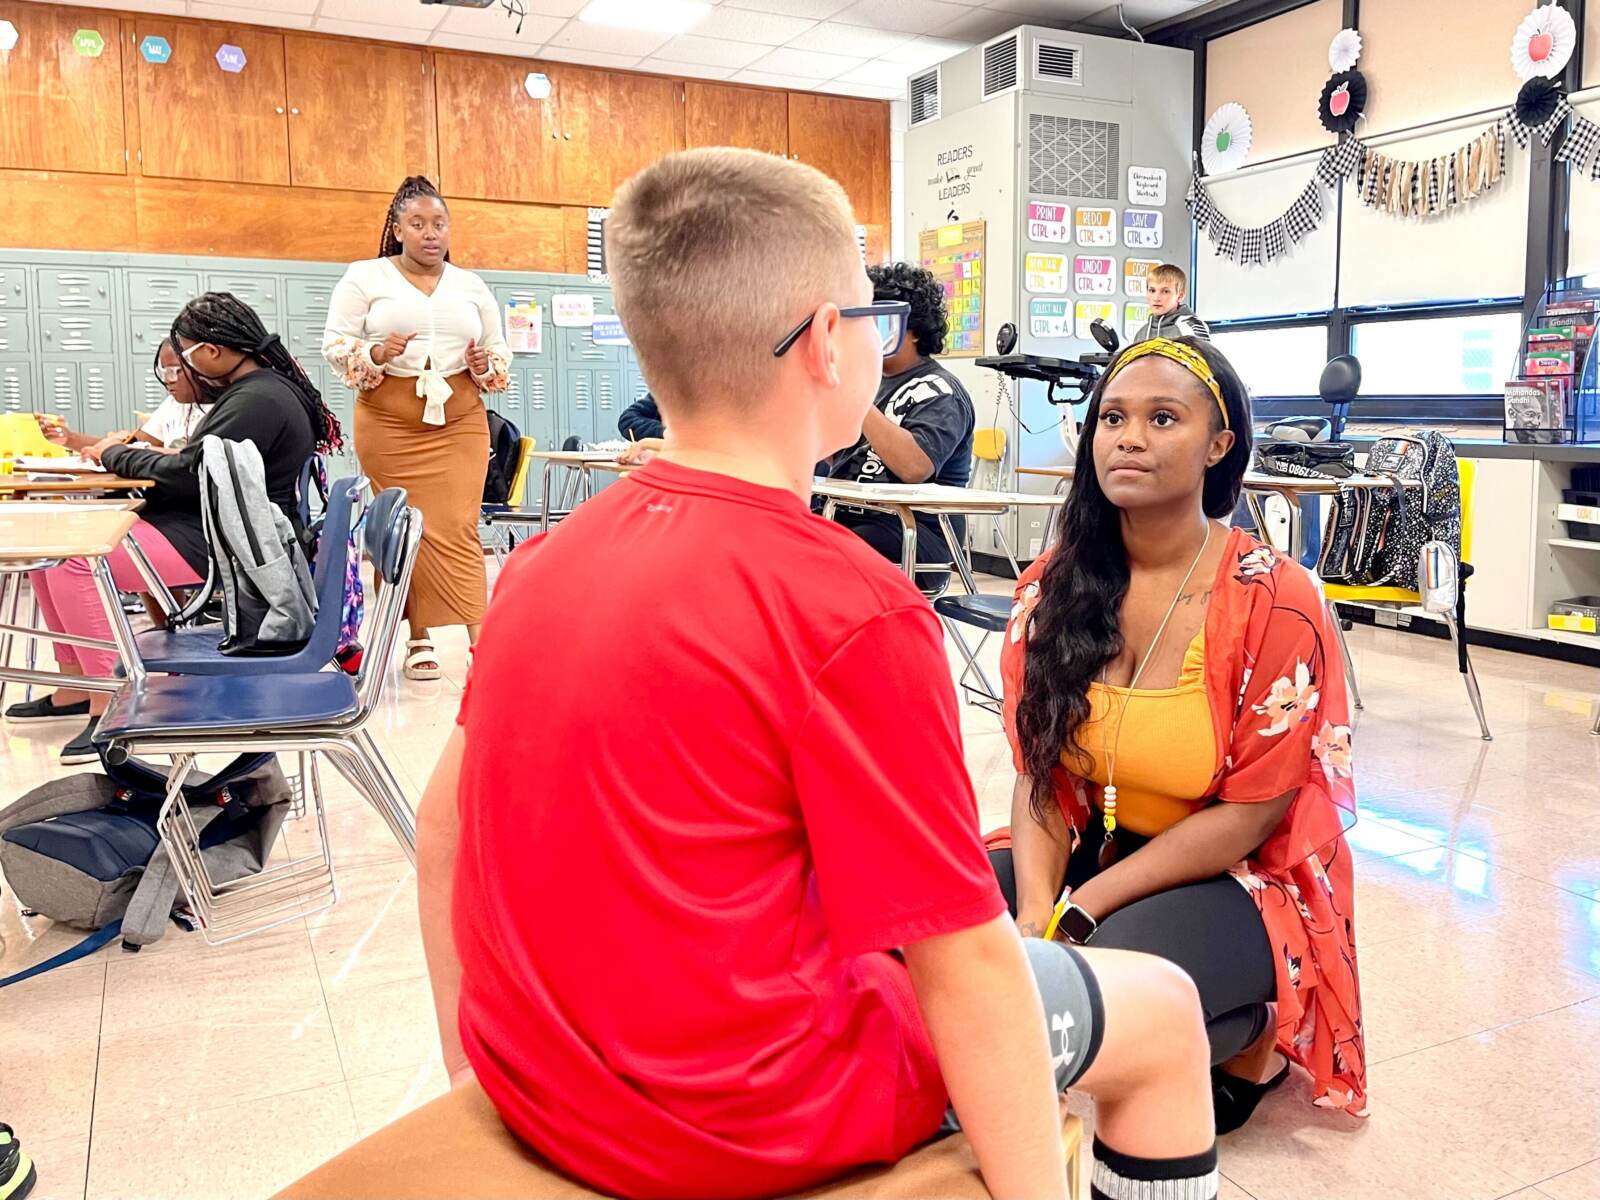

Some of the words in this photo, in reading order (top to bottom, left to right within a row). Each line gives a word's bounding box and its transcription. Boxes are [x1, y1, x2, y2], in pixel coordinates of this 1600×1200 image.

[937, 144, 973, 166] READERS
[938, 182, 971, 201] LEADERS
[1035, 205, 1057, 221] PRINT
[1083, 211, 1103, 225] REDO
[1131, 213, 1148, 227] SAVE
[1031, 223, 1049, 238] CTRL
[1060, 226, 1066, 240] P
[1079, 229, 1095, 243] CTRL
[1127, 231, 1143, 244] CTRL
[1153, 232, 1159, 245] S
[1082, 261, 1103, 273] UNDO
[1132, 262, 1149, 276] COPY
[1029, 274, 1046, 288] CTRL
[1078, 277, 1095, 291] CTRL
[1107, 278, 1112, 291] Z
[1127, 279, 1143, 293] CTRL
[1035, 303, 1051, 313] SELECT
[1052, 304, 1063, 313] ALL
[1034, 320, 1050, 333] CTRL
[1062, 321, 1069, 333] A
